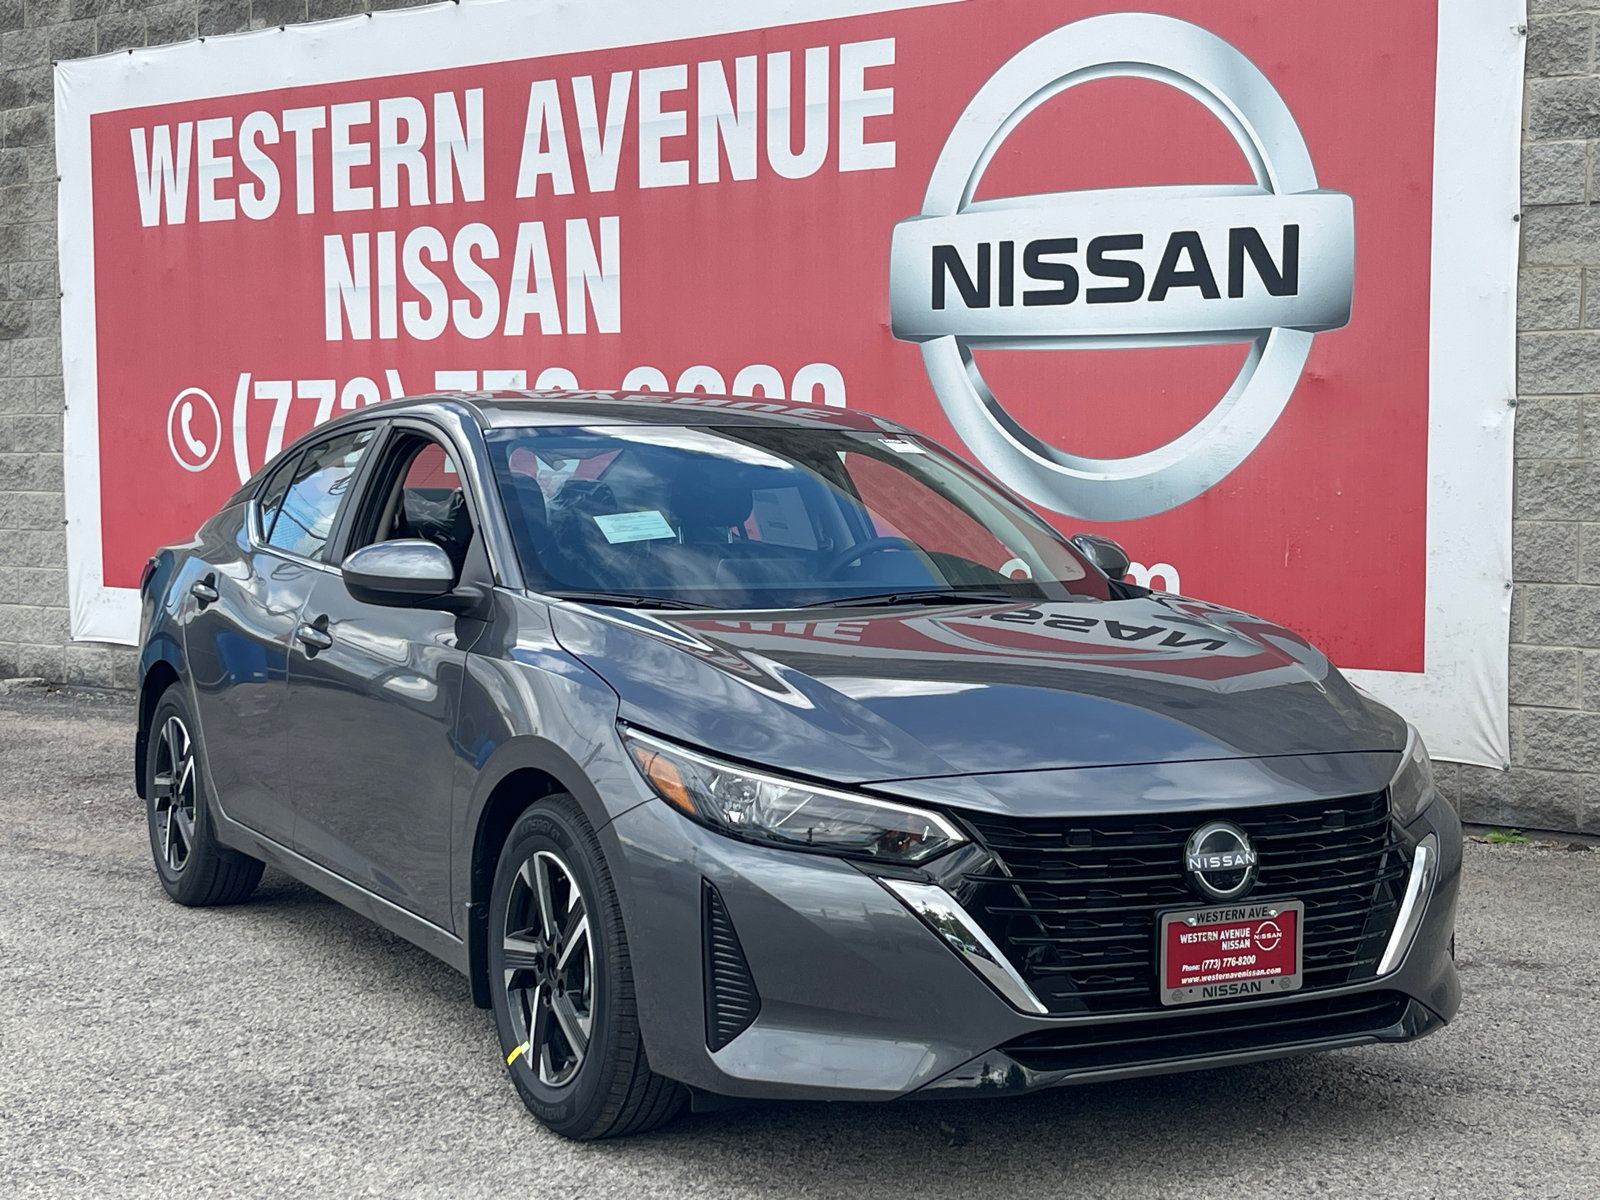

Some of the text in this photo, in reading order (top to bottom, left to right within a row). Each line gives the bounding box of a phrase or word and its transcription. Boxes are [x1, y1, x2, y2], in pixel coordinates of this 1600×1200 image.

[130, 37, 897, 227] WESTERN AVENUE
[932, 224, 1299, 310] NISSAN
[323, 216, 621, 341] NISSAN
[1188, 852, 1255, 869] NISSAN
[1196, 908, 1246, 924] WESTERN
[1180, 927, 1251, 944] WESTERN AVENUE
[1254, 932, 1282, 940] NISSAN
[1221, 939, 1251, 951] NISSAN
[1182, 955, 1256, 972] Phone: (773) 776-8200
[1181, 967, 1282, 985] www.westernavenissan.com
[1202, 980, 1262, 999] NISSAN
